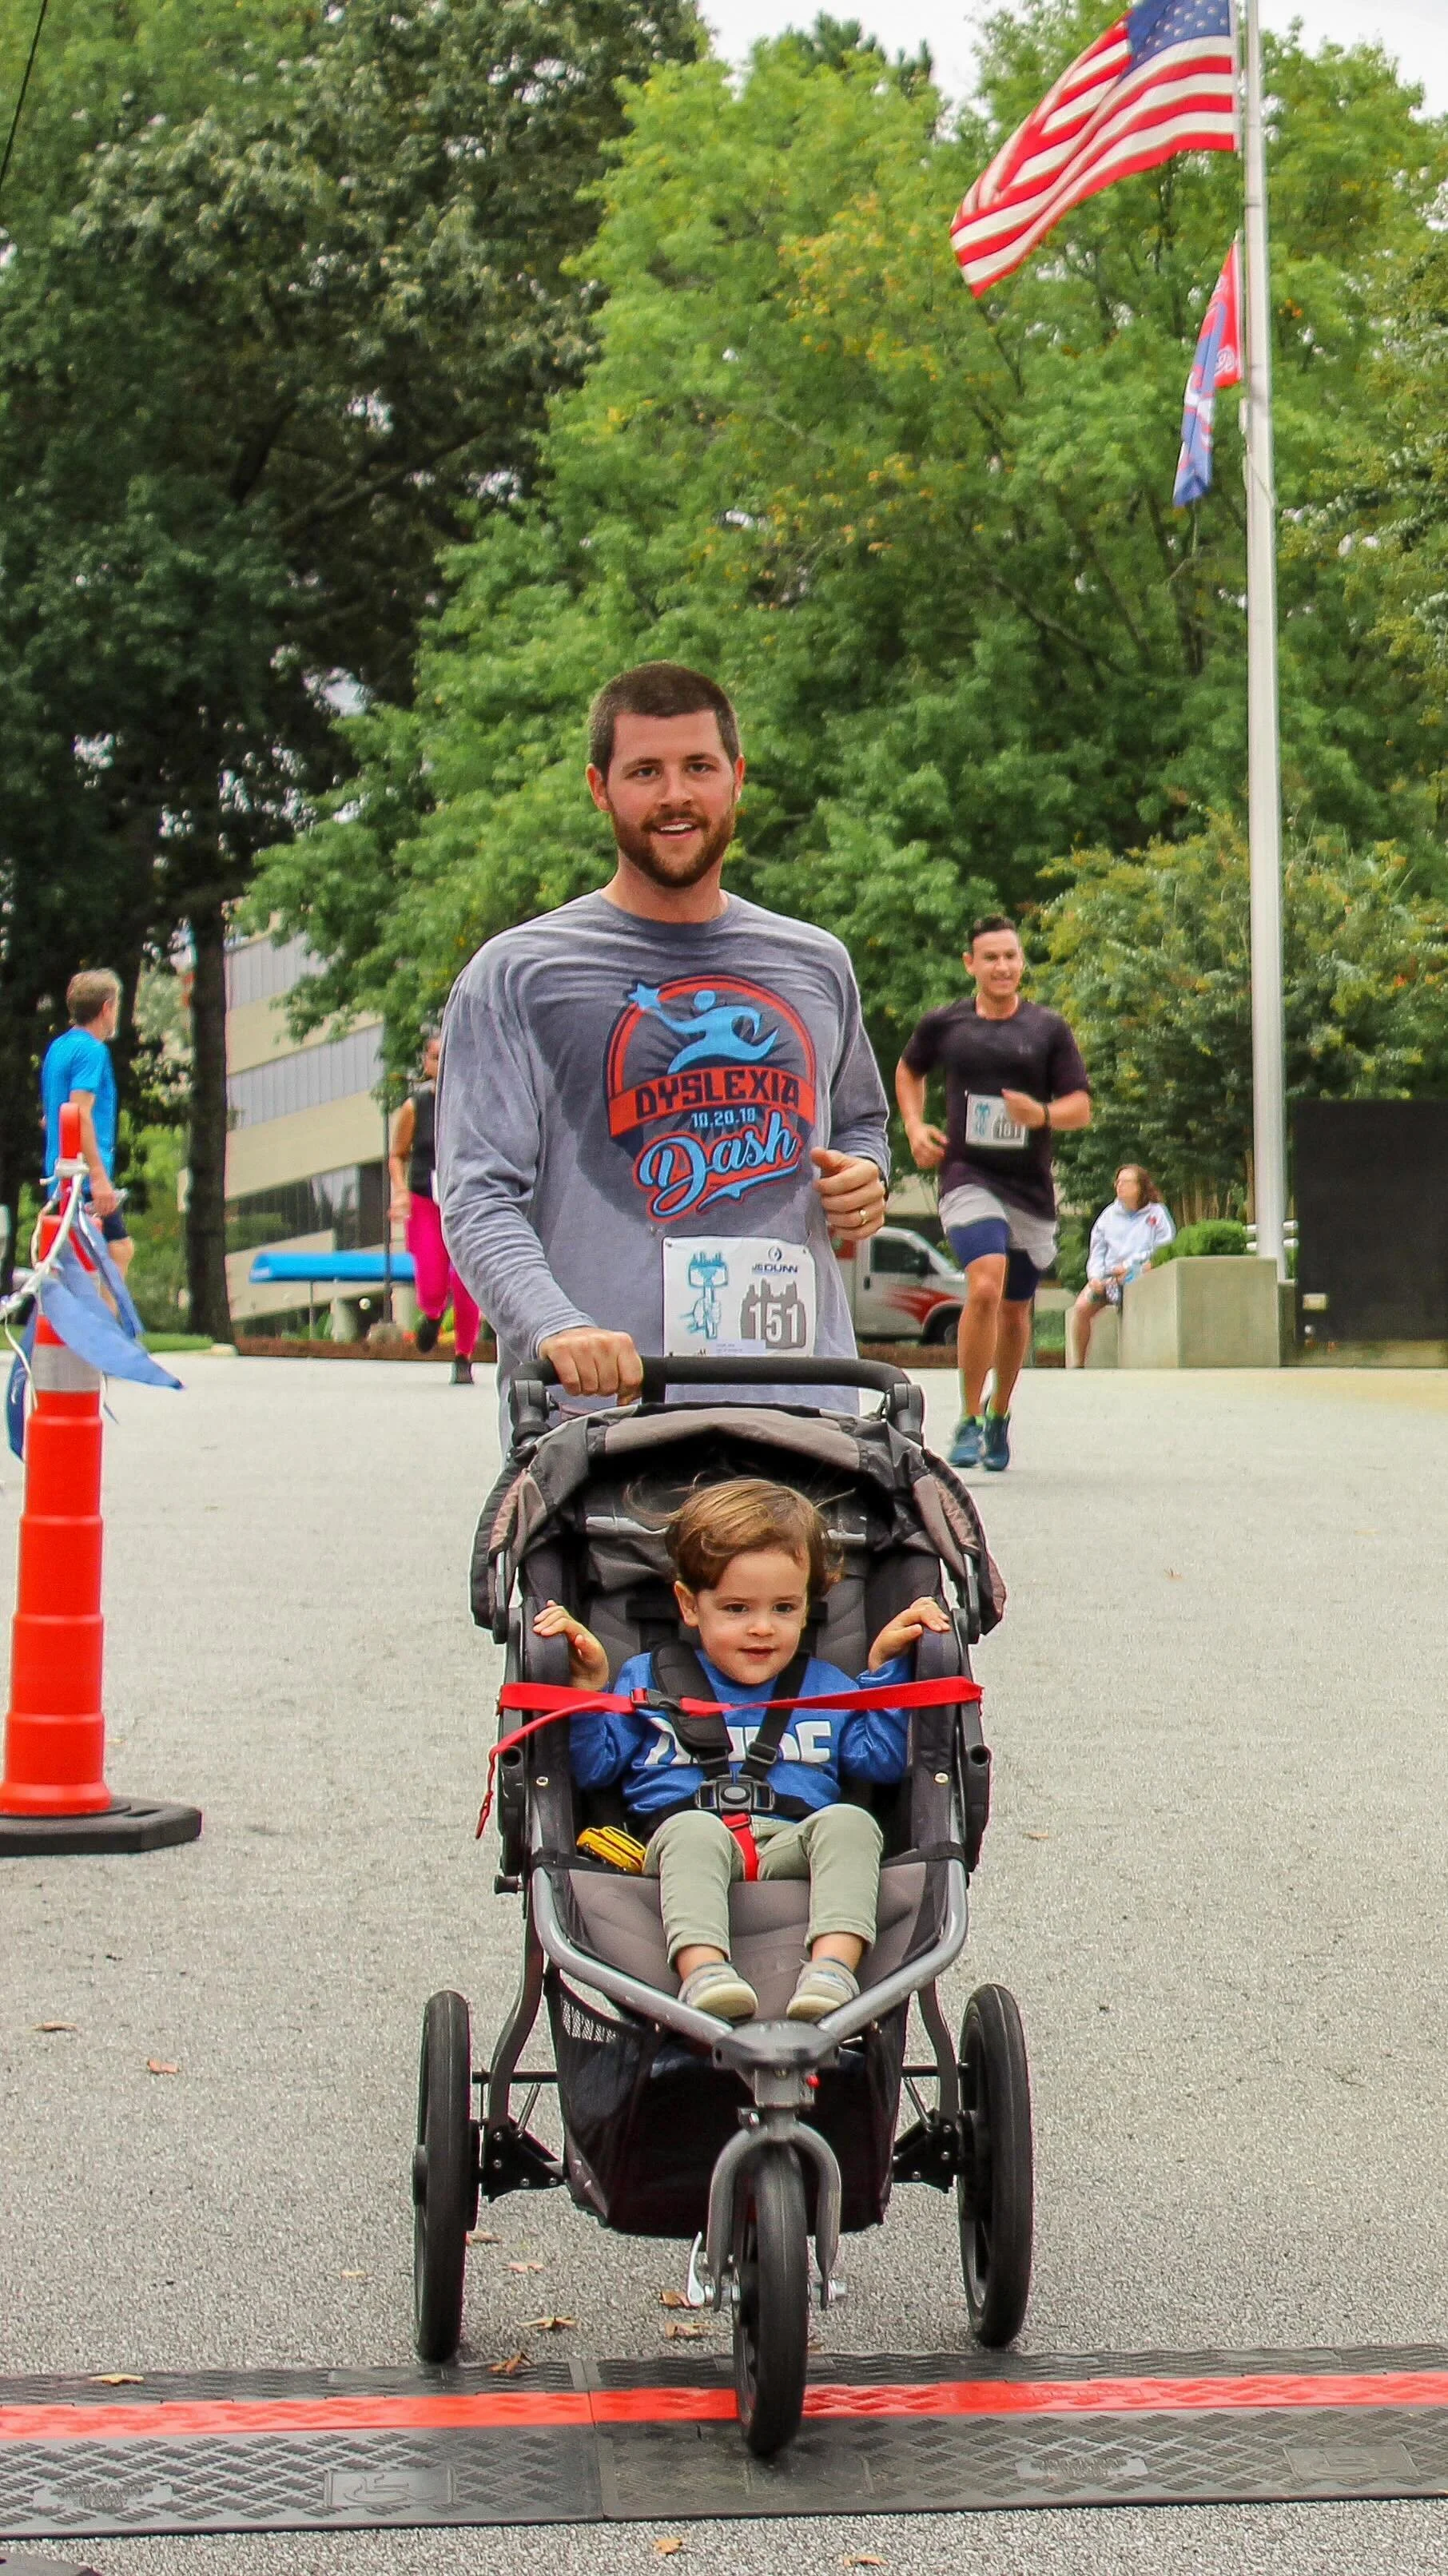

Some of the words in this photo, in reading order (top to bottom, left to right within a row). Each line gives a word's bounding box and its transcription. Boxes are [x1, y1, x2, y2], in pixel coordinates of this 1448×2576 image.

[634, 1069, 800, 1119] DYSLEXIA
[638, 1111, 798, 1217] Dash
[748, 1302, 798, 1343] 151
